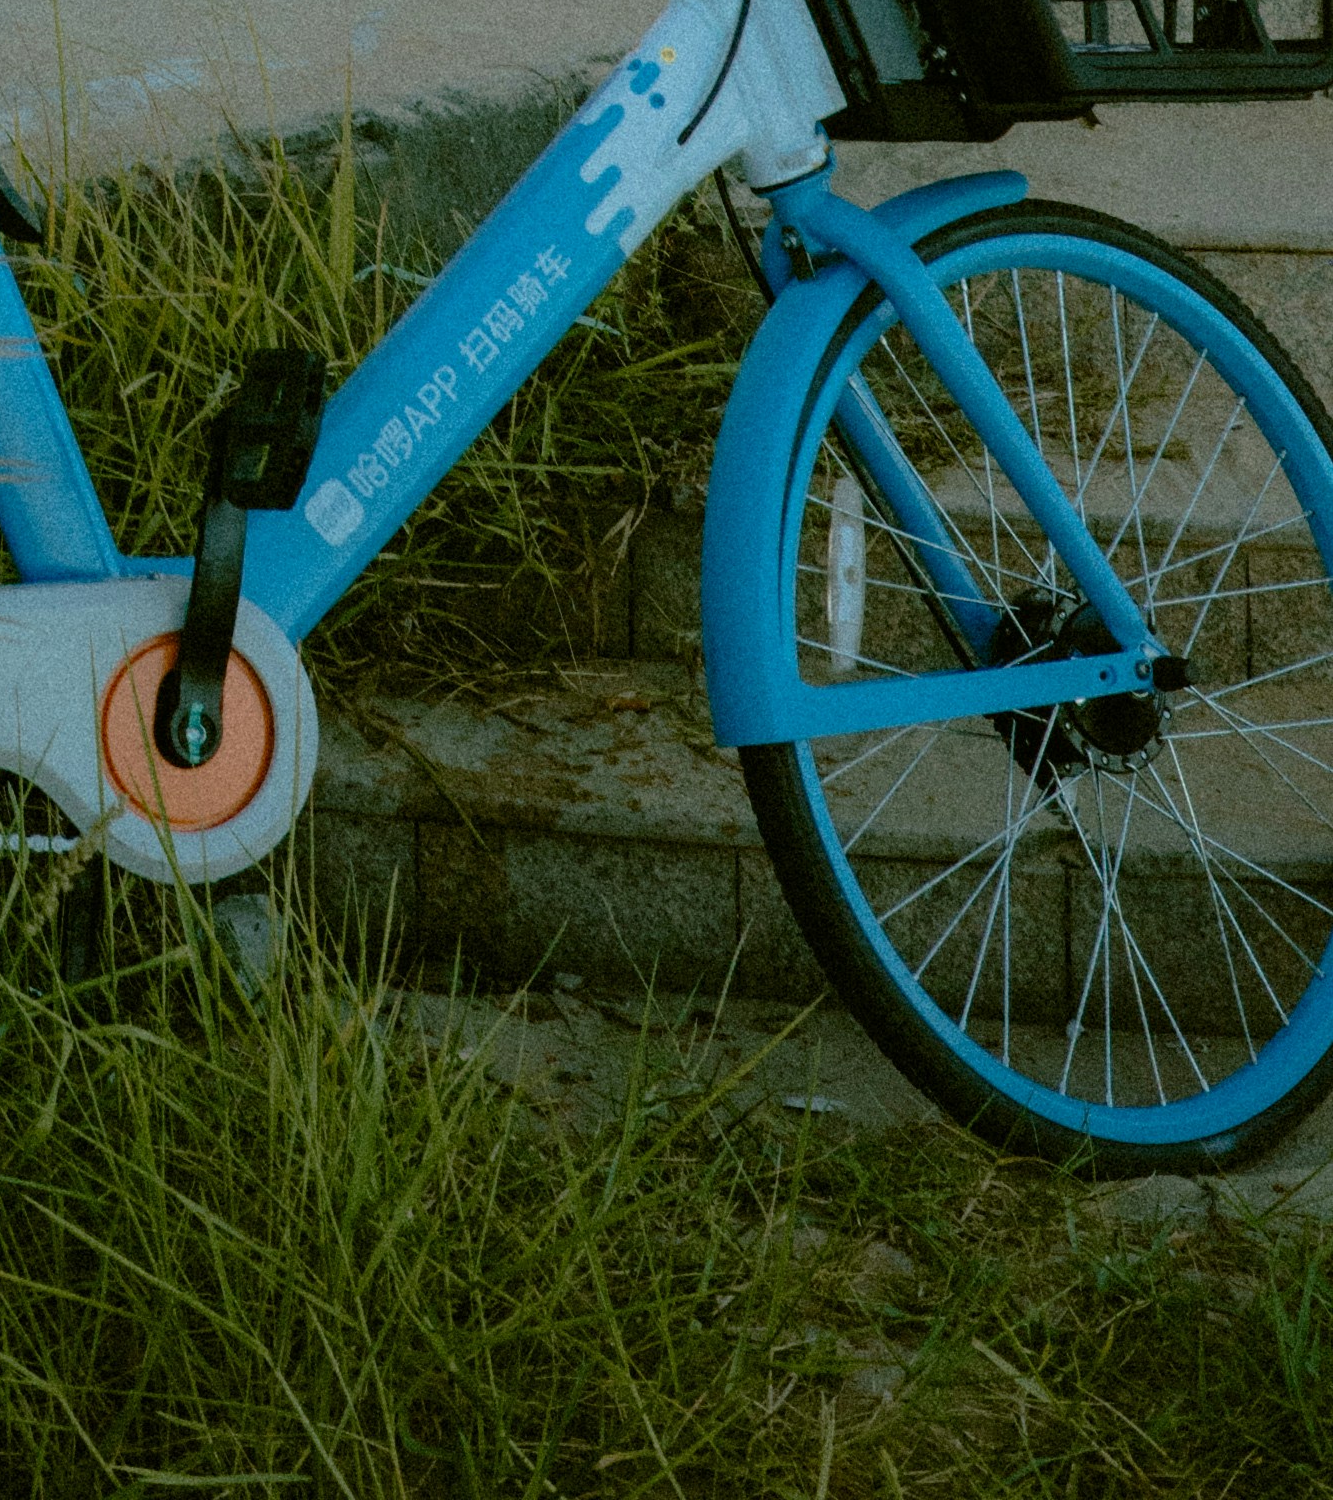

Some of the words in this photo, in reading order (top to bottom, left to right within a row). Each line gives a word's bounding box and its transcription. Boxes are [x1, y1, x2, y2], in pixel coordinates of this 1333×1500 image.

[347, 365, 458, 498] 哈啰APP
[458, 244, 572, 375] 扫码骑车
